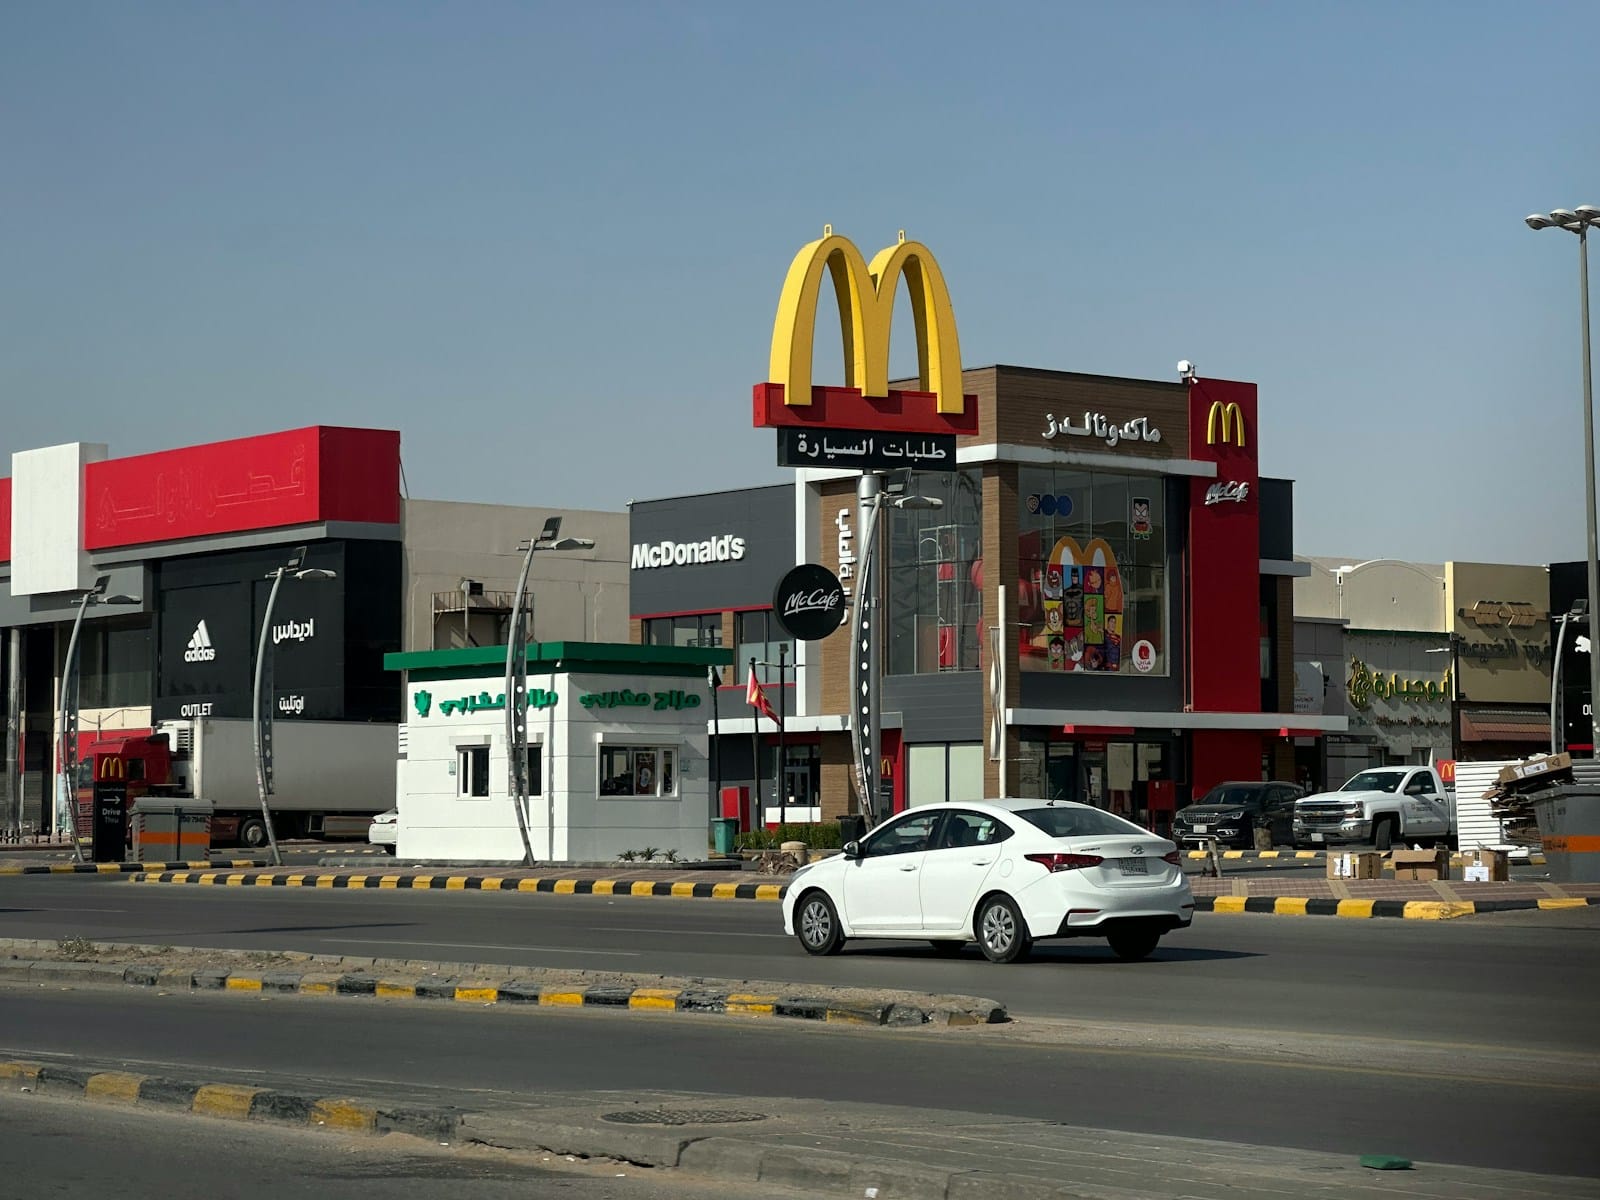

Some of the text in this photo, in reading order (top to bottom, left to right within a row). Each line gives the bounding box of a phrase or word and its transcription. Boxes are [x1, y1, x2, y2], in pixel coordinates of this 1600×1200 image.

[1042, 412, 1161, 447] ماكدونالدز
[797, 434, 946, 462] طلبات السيارة
[631, 534, 746, 570] McDonald's
[784, 588, 840, 616] McCafé
[272, 618, 314, 644] اديداس
[184, 647, 216, 662] adidas
[181, 702, 213, 717] OUTLET
[102, 807, 121, 816] Drive
